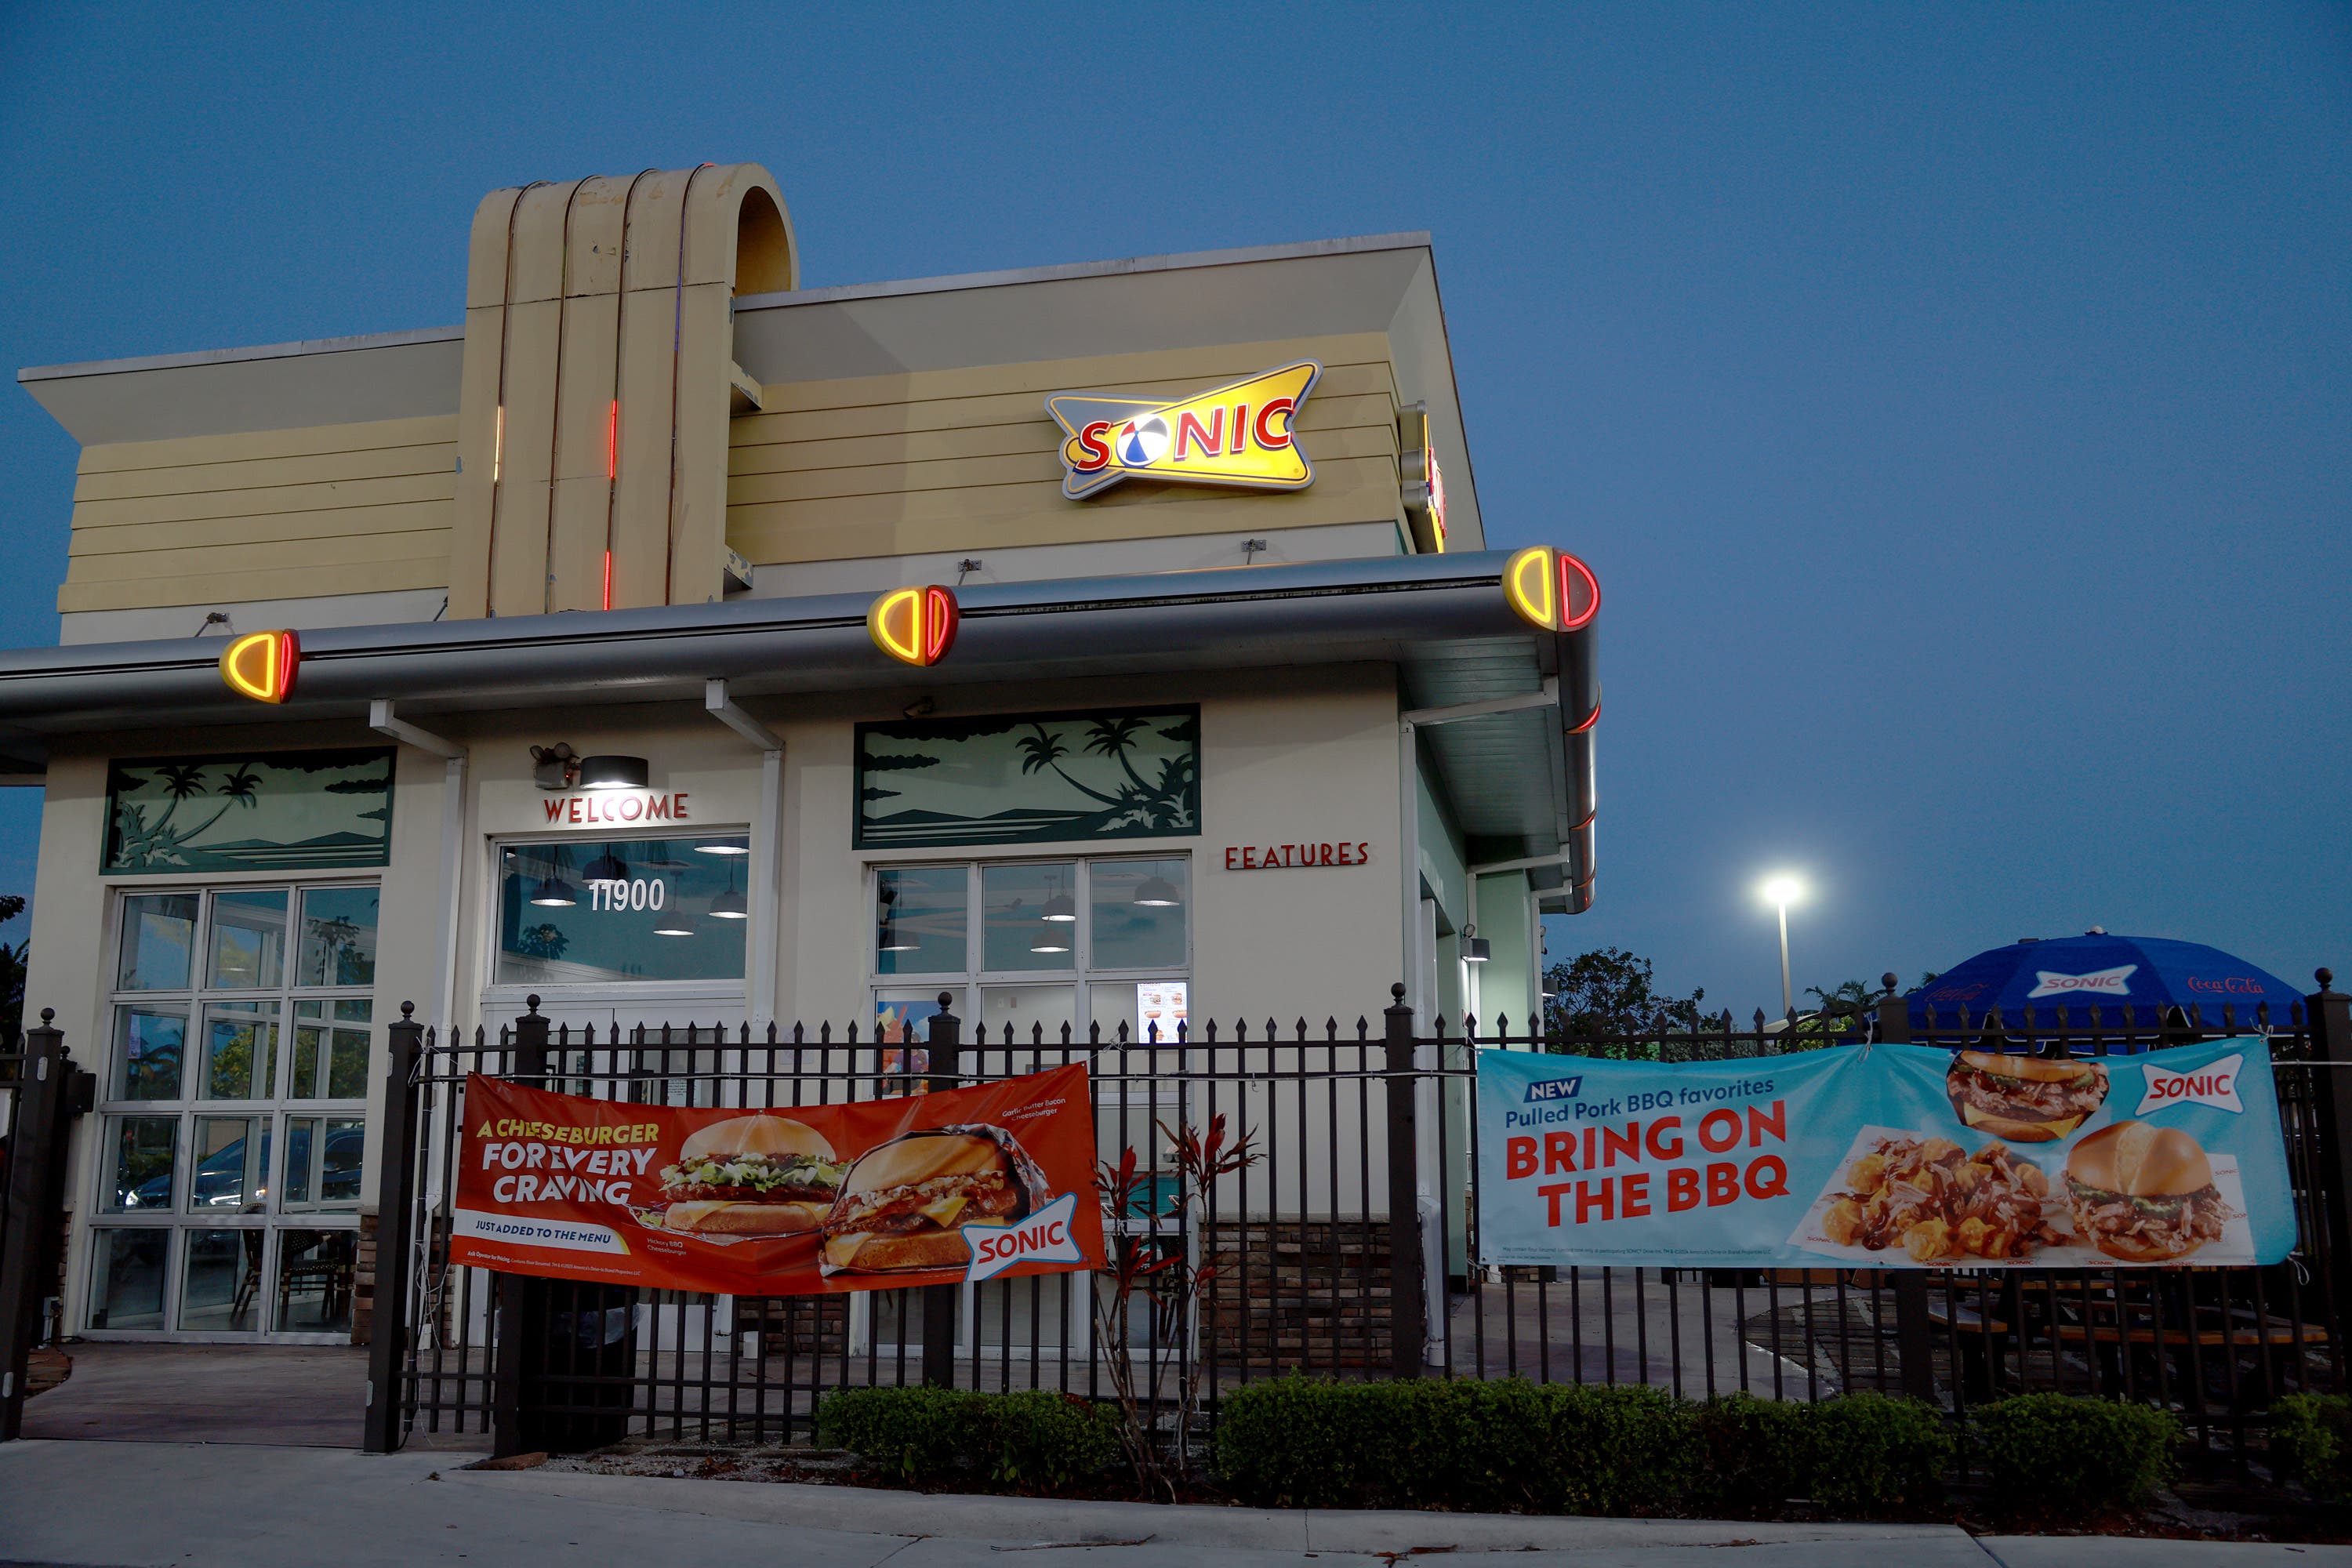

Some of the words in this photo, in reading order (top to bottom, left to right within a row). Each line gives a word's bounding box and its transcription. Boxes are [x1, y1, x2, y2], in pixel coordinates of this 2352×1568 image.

[1074, 397, 1295, 474] SONIC
[543, 793, 688, 822] WELCOME
[1225, 842, 1369, 870] FEATURES
[589, 878, 665, 911] 11900
[2042, 975, 2121, 989] SONIC
[1530, 1078, 1577, 1100] NEW
[2149, 1074, 2230, 1099] SONIC
[1002, 1107, 1022, 1117] Garlic
[1506, 1104, 1569, 1128] Pulled
[1575, 1098, 1621, 1120] Pork
[1628, 1090, 1675, 1113] BBQ
[1679, 1079, 1775, 1105] favorites
[476, 1120, 493, 1138] A
[1507, 1116, 1683, 1180] BRING
[1698, 1099, 1787, 1153] ON
[492, 1175, 632, 1205] CRAVING
[1537, 1172, 1650, 1228] THE
[1668, 1154, 1791, 1213] BBQ
[476, 1220, 496, 1232] JUST
[496, 1224, 534, 1236] ADDED
[536, 1228, 552, 1238] TO
[554, 1230, 575, 1240] THE
[579, 1232, 611, 1244] MENU
[978, 1221, 1065, 1265] SONIC
